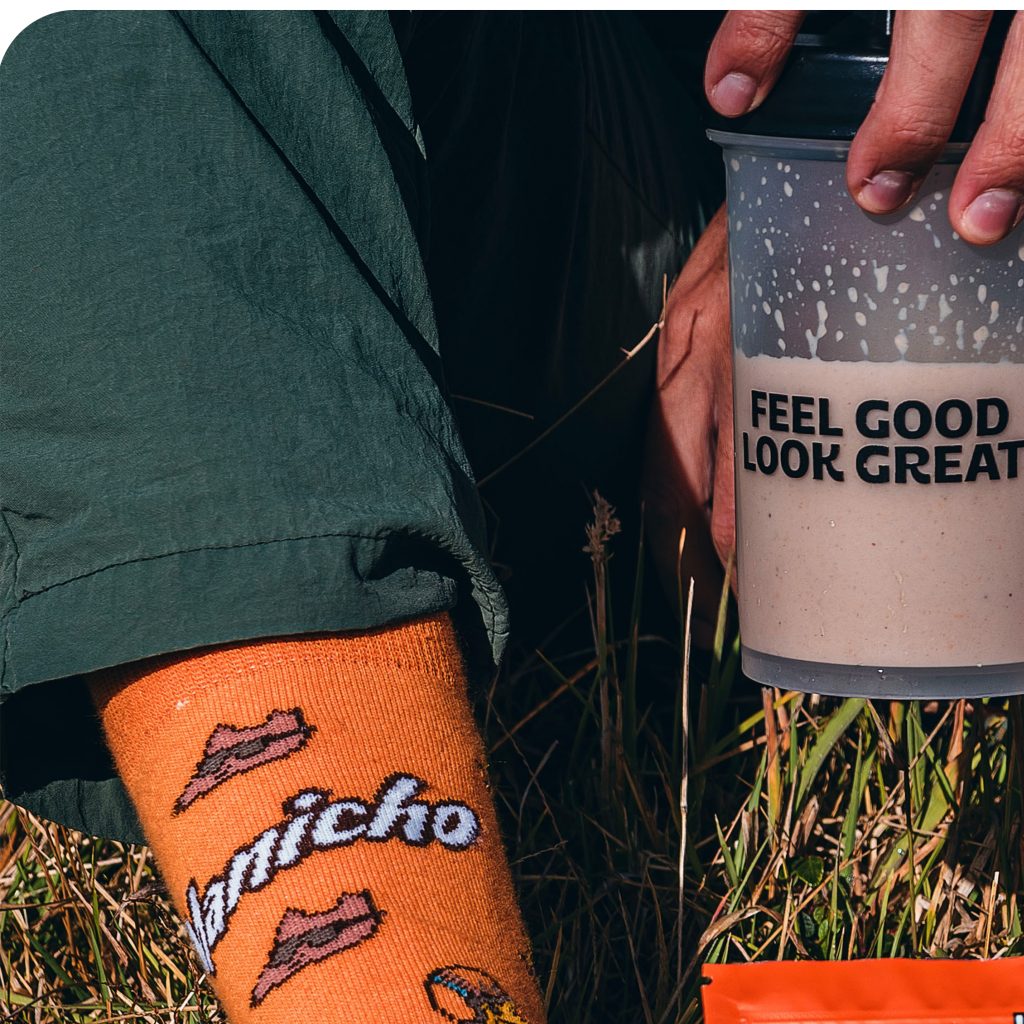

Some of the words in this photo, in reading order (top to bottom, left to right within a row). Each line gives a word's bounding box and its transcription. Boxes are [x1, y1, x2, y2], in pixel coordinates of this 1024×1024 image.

[752, 390, 844, 437] FEEL
[855, 397, 1010, 440] GOOD
[743, 432, 845, 482] LOOK
